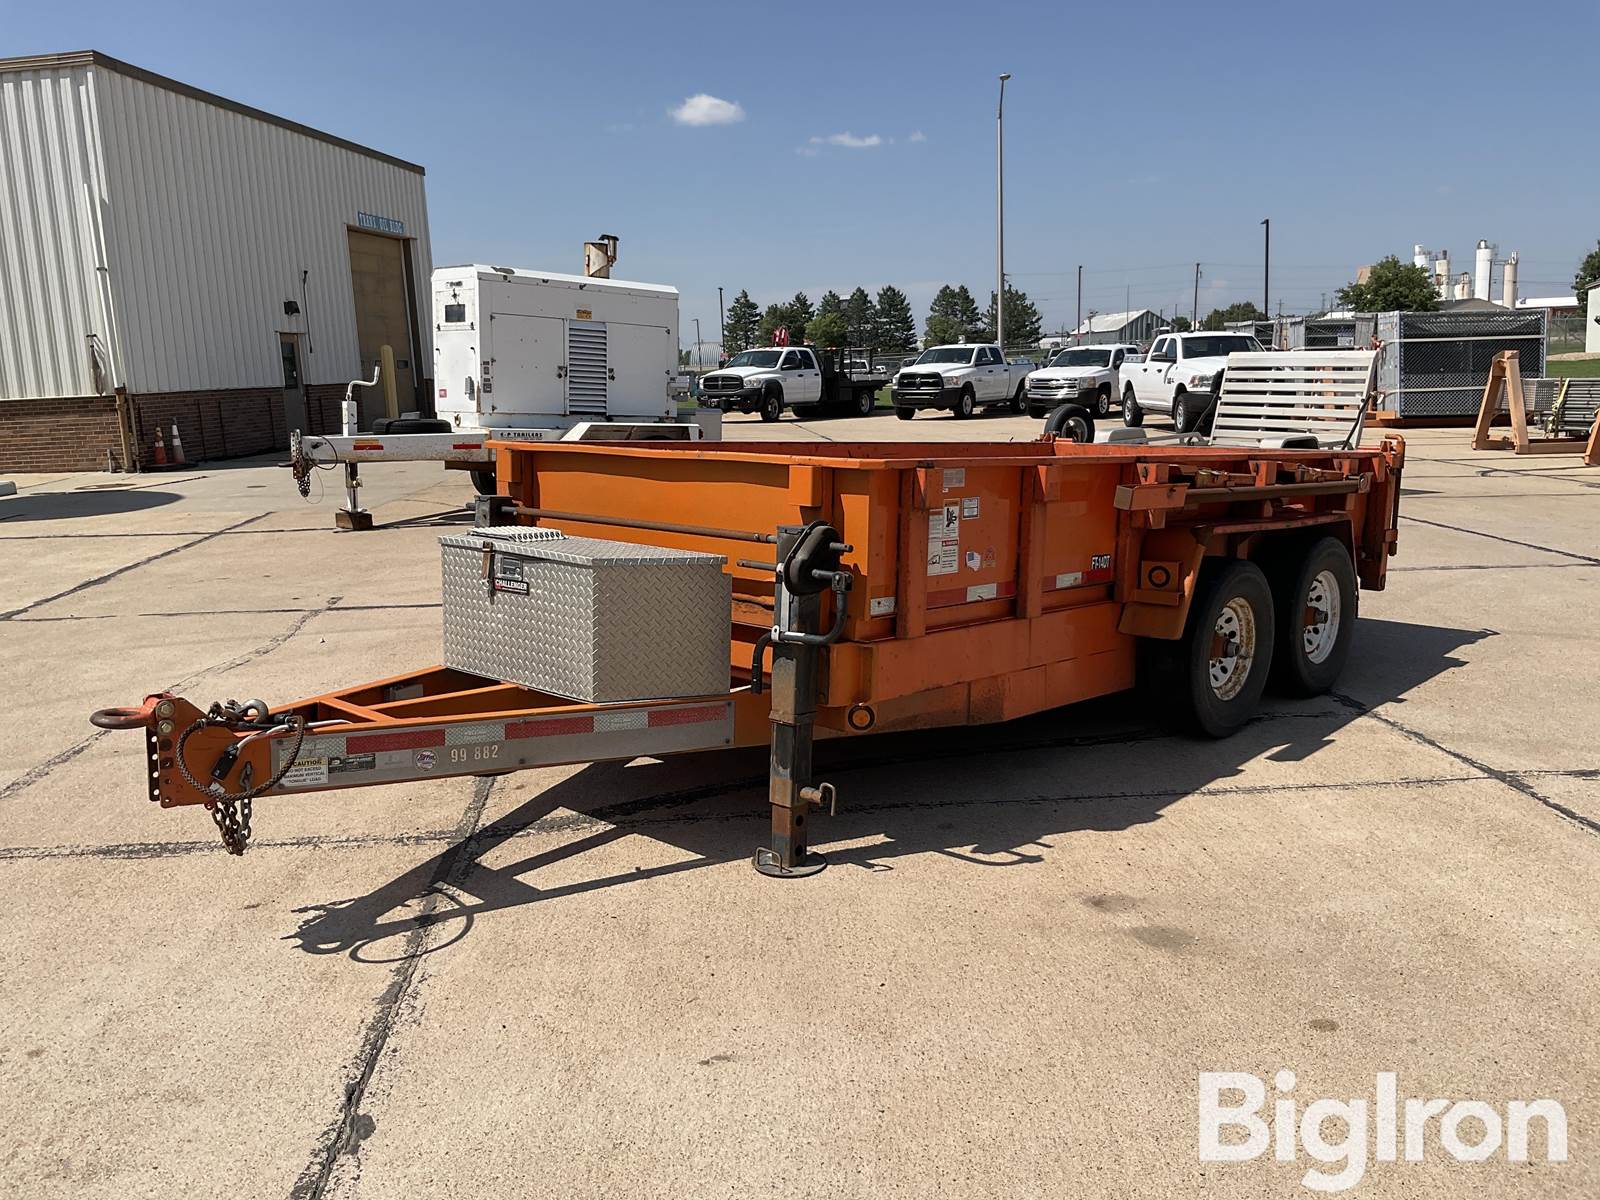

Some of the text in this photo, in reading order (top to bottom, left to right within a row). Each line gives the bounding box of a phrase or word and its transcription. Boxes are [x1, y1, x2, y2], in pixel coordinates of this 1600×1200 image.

[495, 579, 528, 590] CHALLENGER
[451, 748, 467, 762] 99
[474, 744, 499, 760] 882
